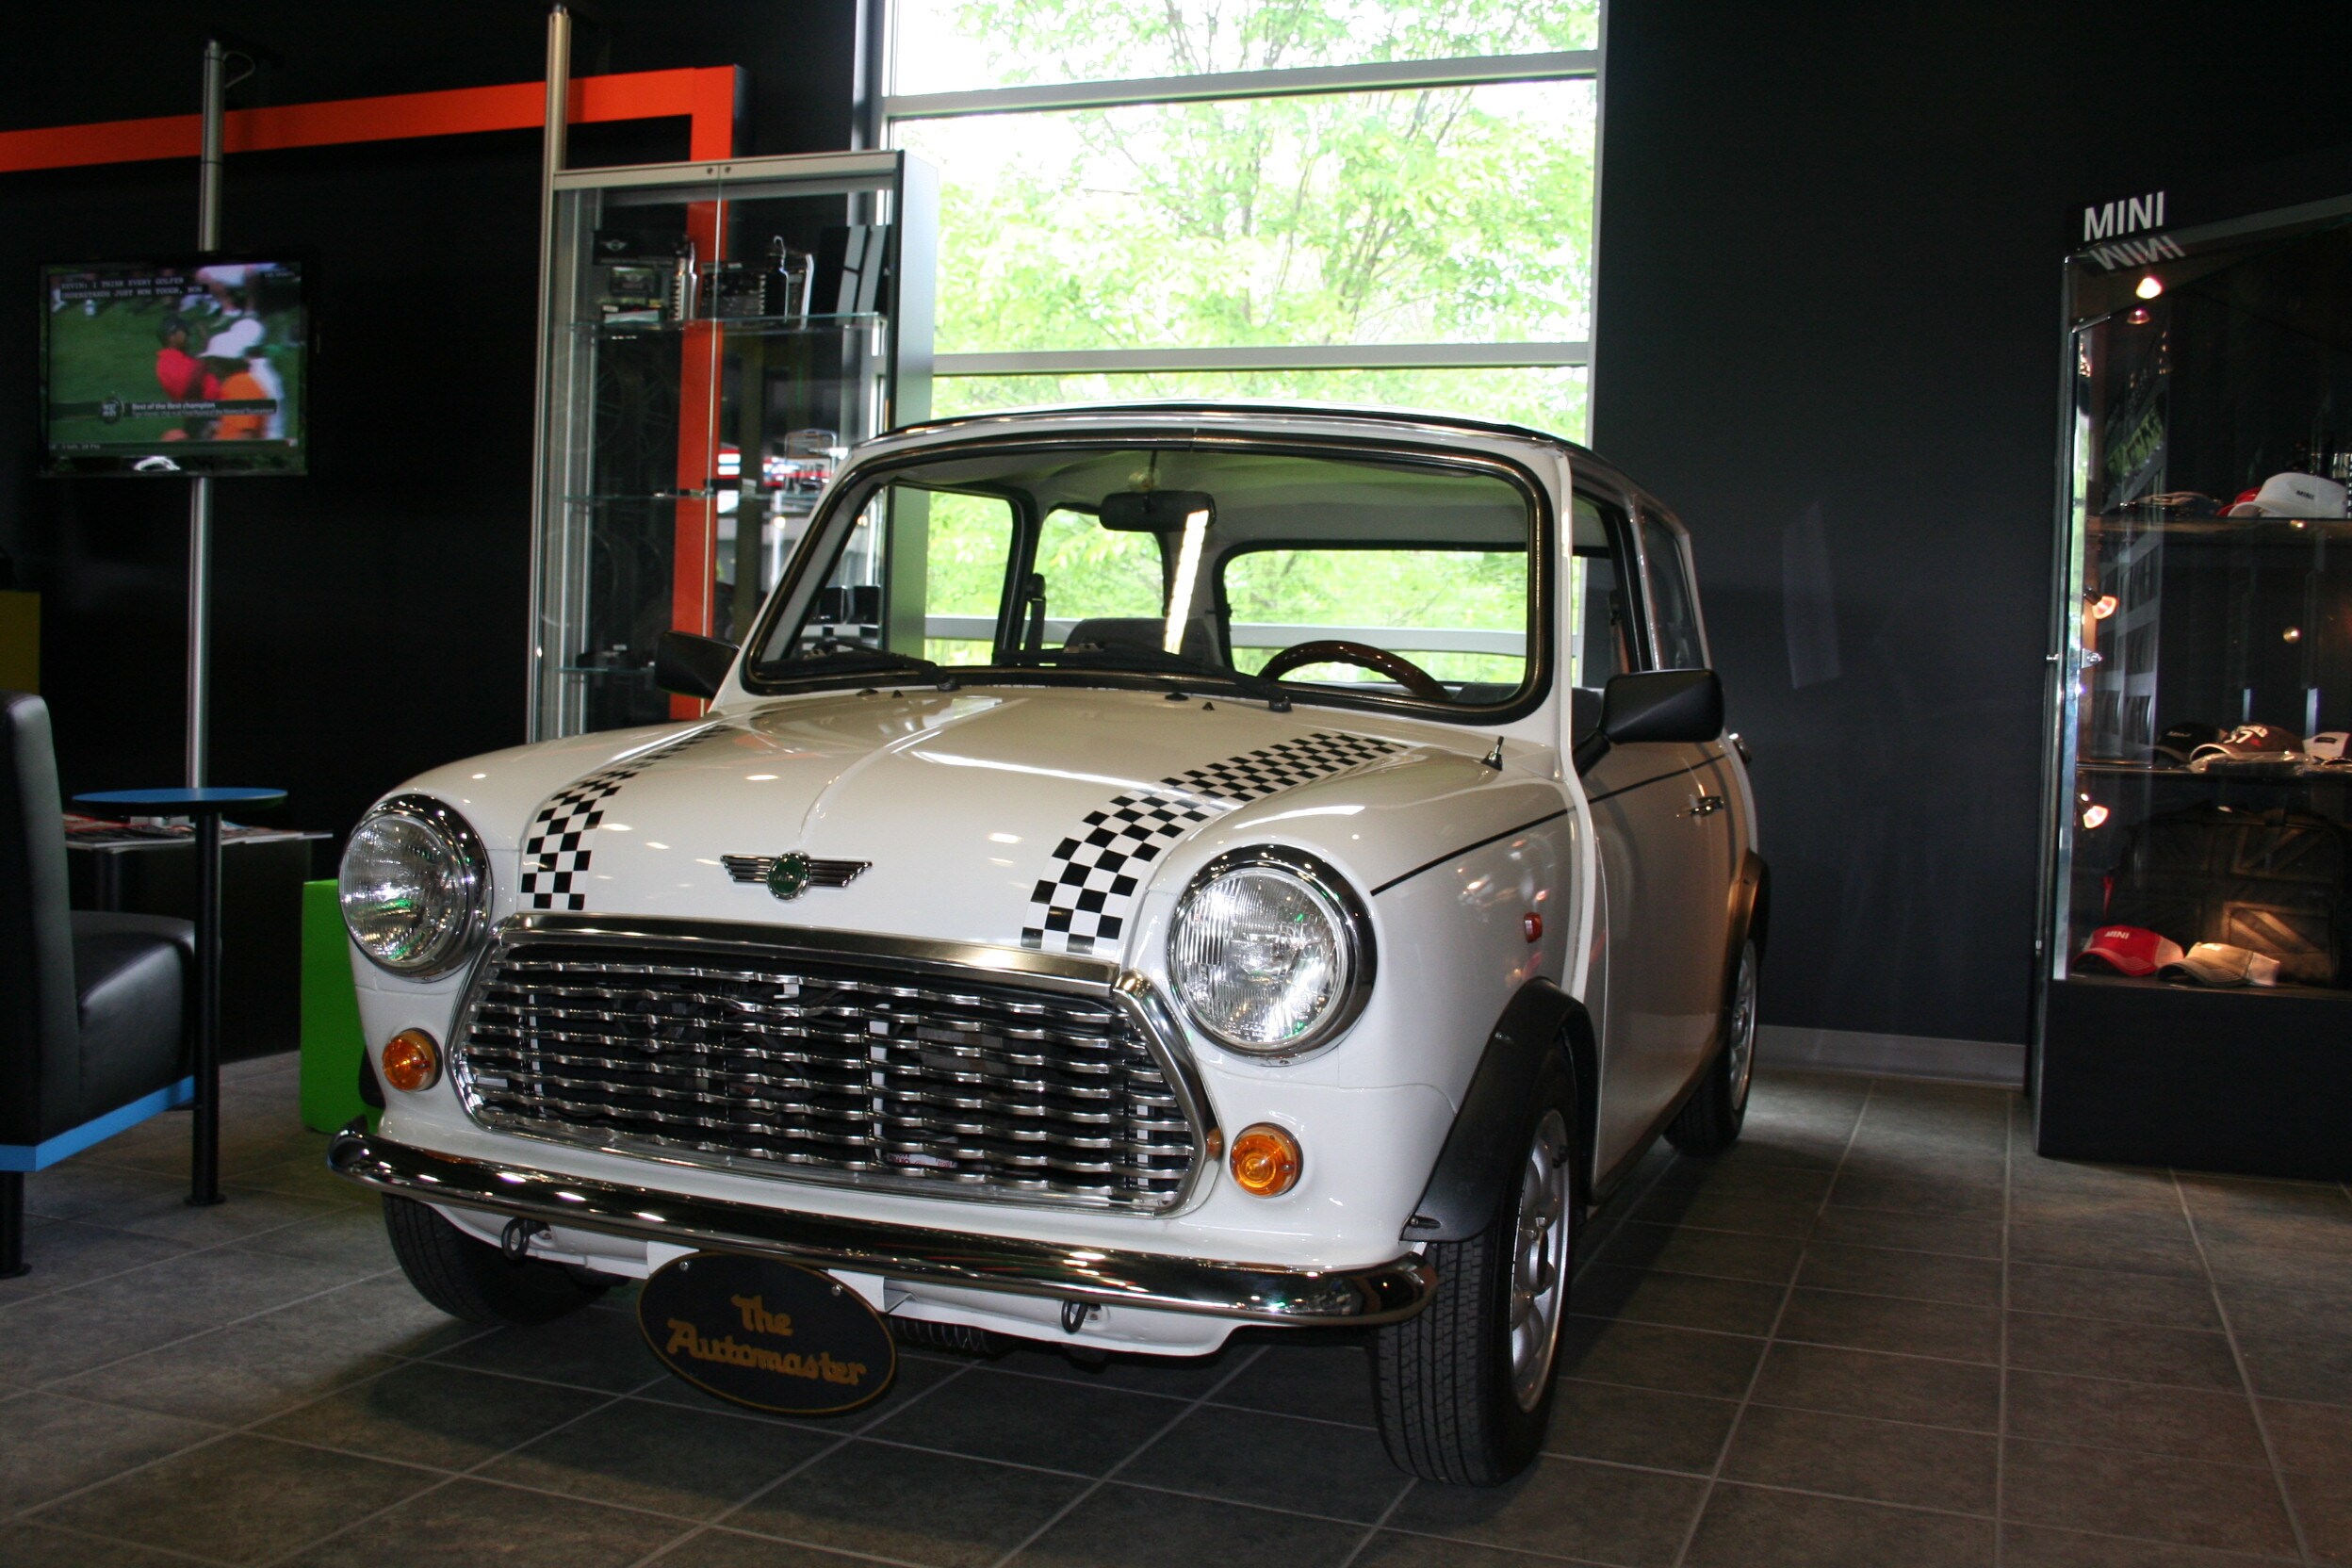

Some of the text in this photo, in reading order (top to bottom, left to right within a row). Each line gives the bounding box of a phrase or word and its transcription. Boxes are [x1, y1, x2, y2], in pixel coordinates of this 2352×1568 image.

[2084, 191, 2164, 242] MINI
[2104, 930, 2130, 939] MINI
[730, 1294, 793, 1336] The
[666, 1318, 867, 1386] Automaster
